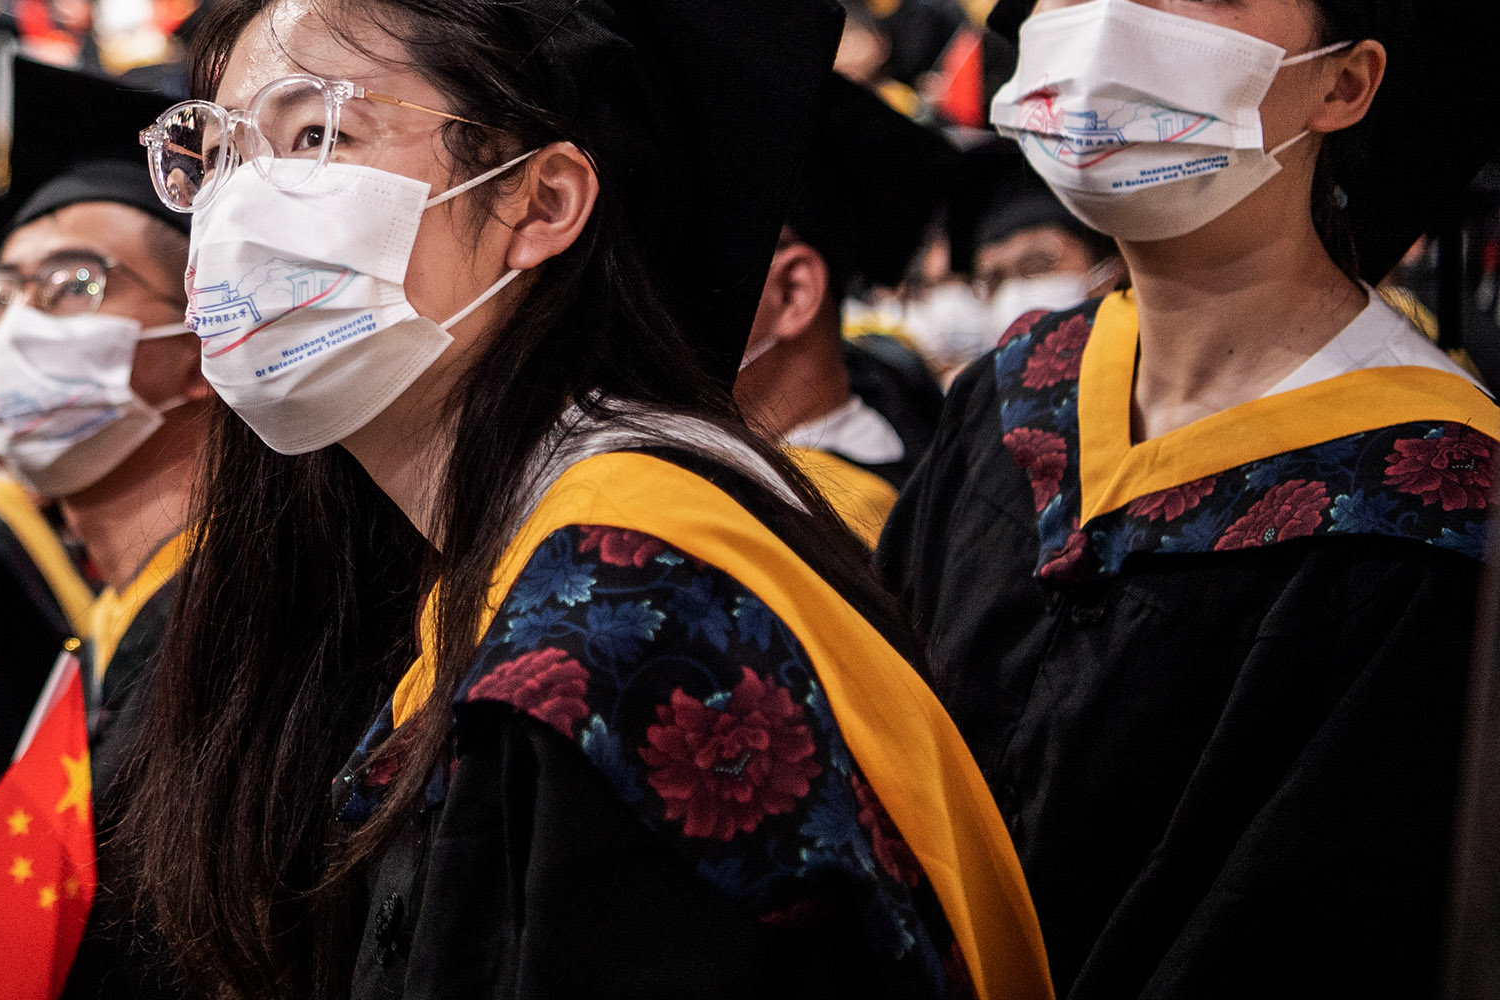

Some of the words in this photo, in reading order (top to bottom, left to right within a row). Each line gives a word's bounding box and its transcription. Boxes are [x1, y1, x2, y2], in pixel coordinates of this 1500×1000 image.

[1163, 172, 1179, 181] and
[255, 368, 266, 378] Of
[268, 354, 304, 374] Science
[306, 345, 323, 358] and
[325, 321, 378, 349] Technology
[281, 335, 326, 358] Huazhong
[328, 313, 373, 338] University
